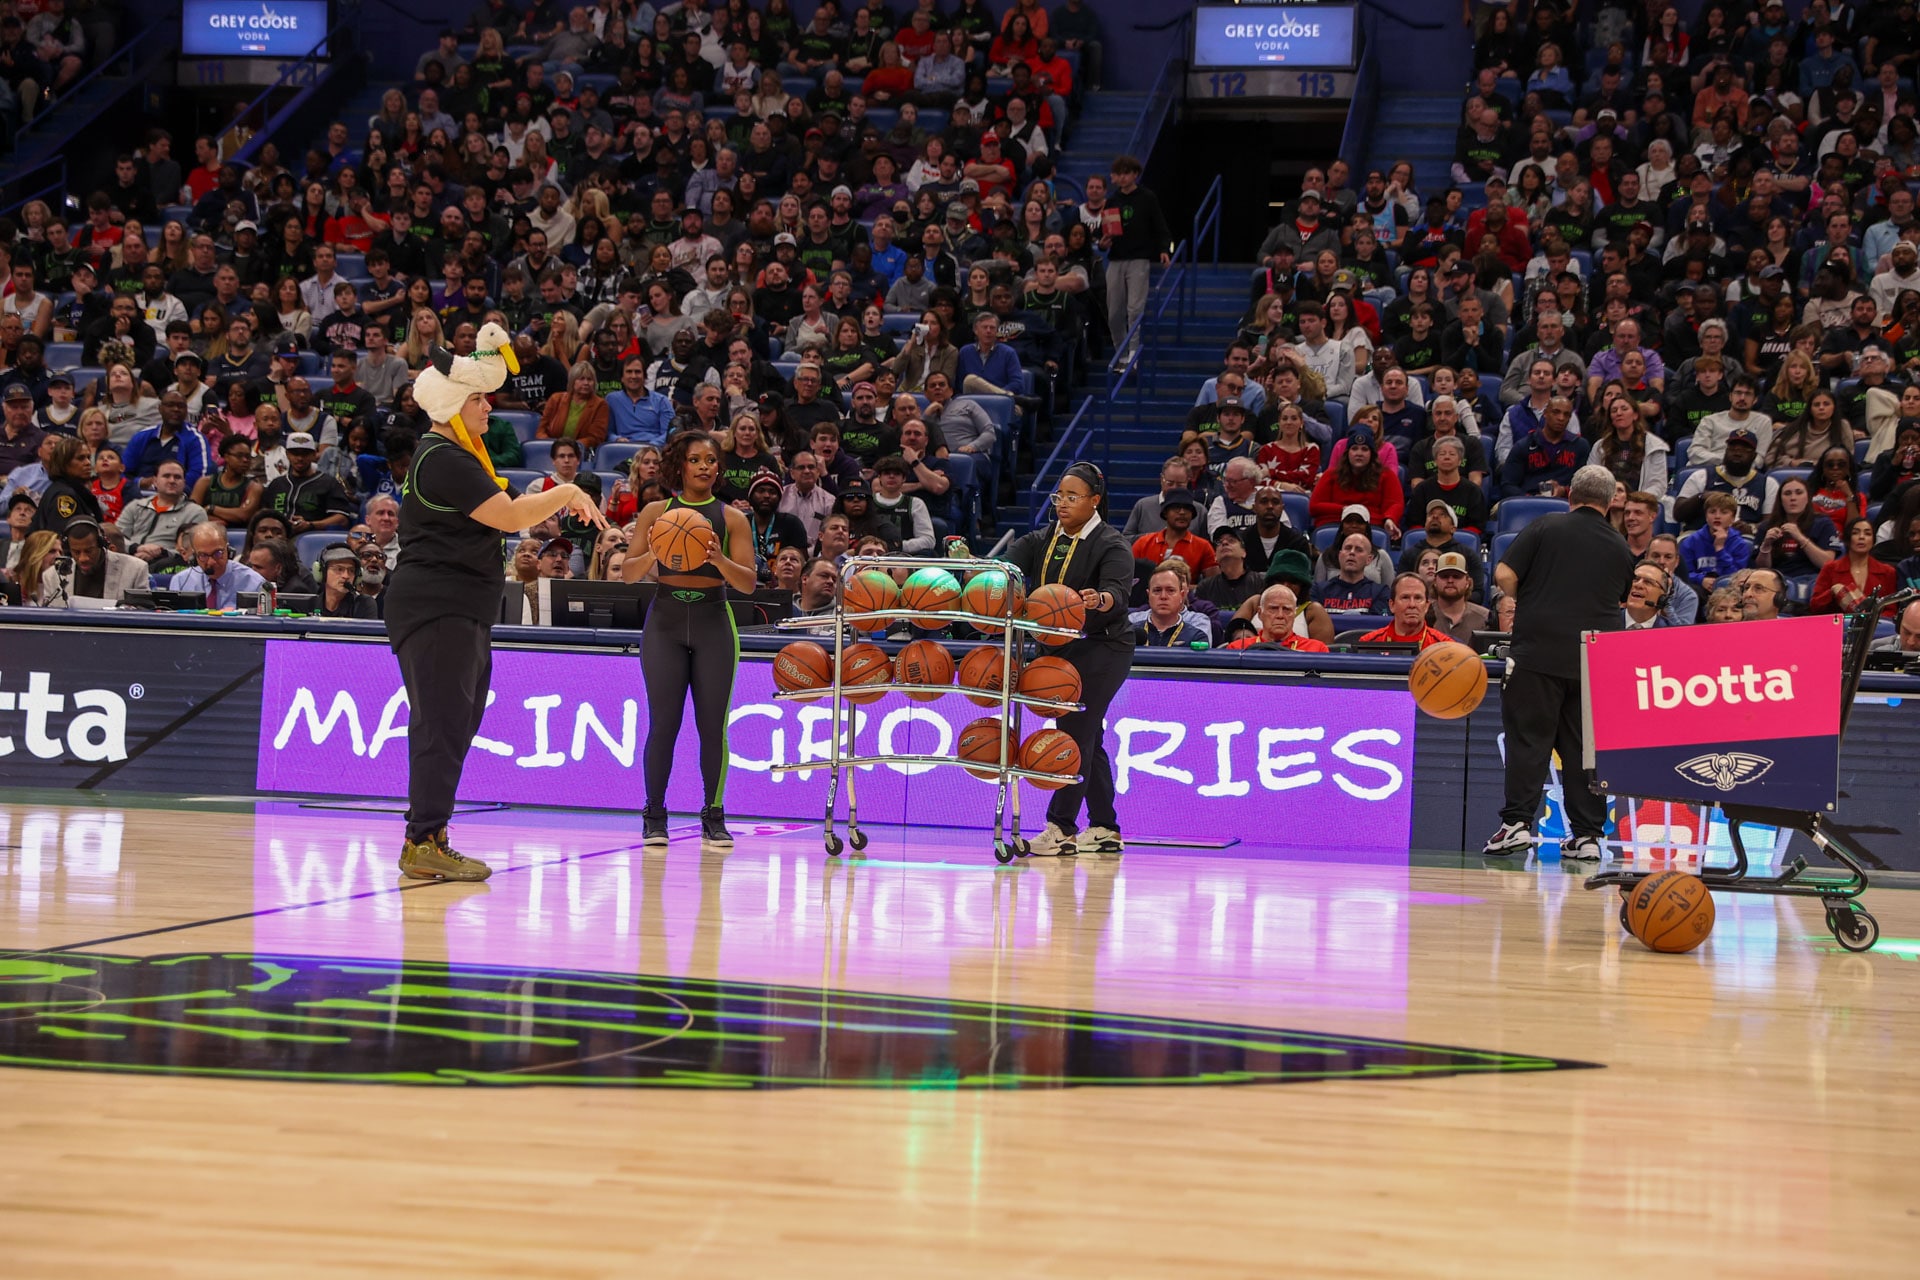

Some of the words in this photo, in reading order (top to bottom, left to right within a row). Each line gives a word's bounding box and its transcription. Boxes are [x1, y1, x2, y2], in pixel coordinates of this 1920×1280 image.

[209, 15, 246, 29] GREY
[248, 15, 298, 29] GOOSE
[238, 32, 270, 41] VODKA
[1224, 24, 1264, 38] GREY
[1267, 24, 1320, 38] GOOSE
[1254, 41, 1290, 51] VODKA
[197, 61, 225, 82] 111
[1209, 72, 1247, 96] 112
[1297, 72, 1335, 97] 113
[512, 375, 544, 388] TEAM
[1324, 598, 1373, 609] PELICANS
[777, 655, 814, 687] Wilson
[1636, 870, 1679, 910] Wilson
